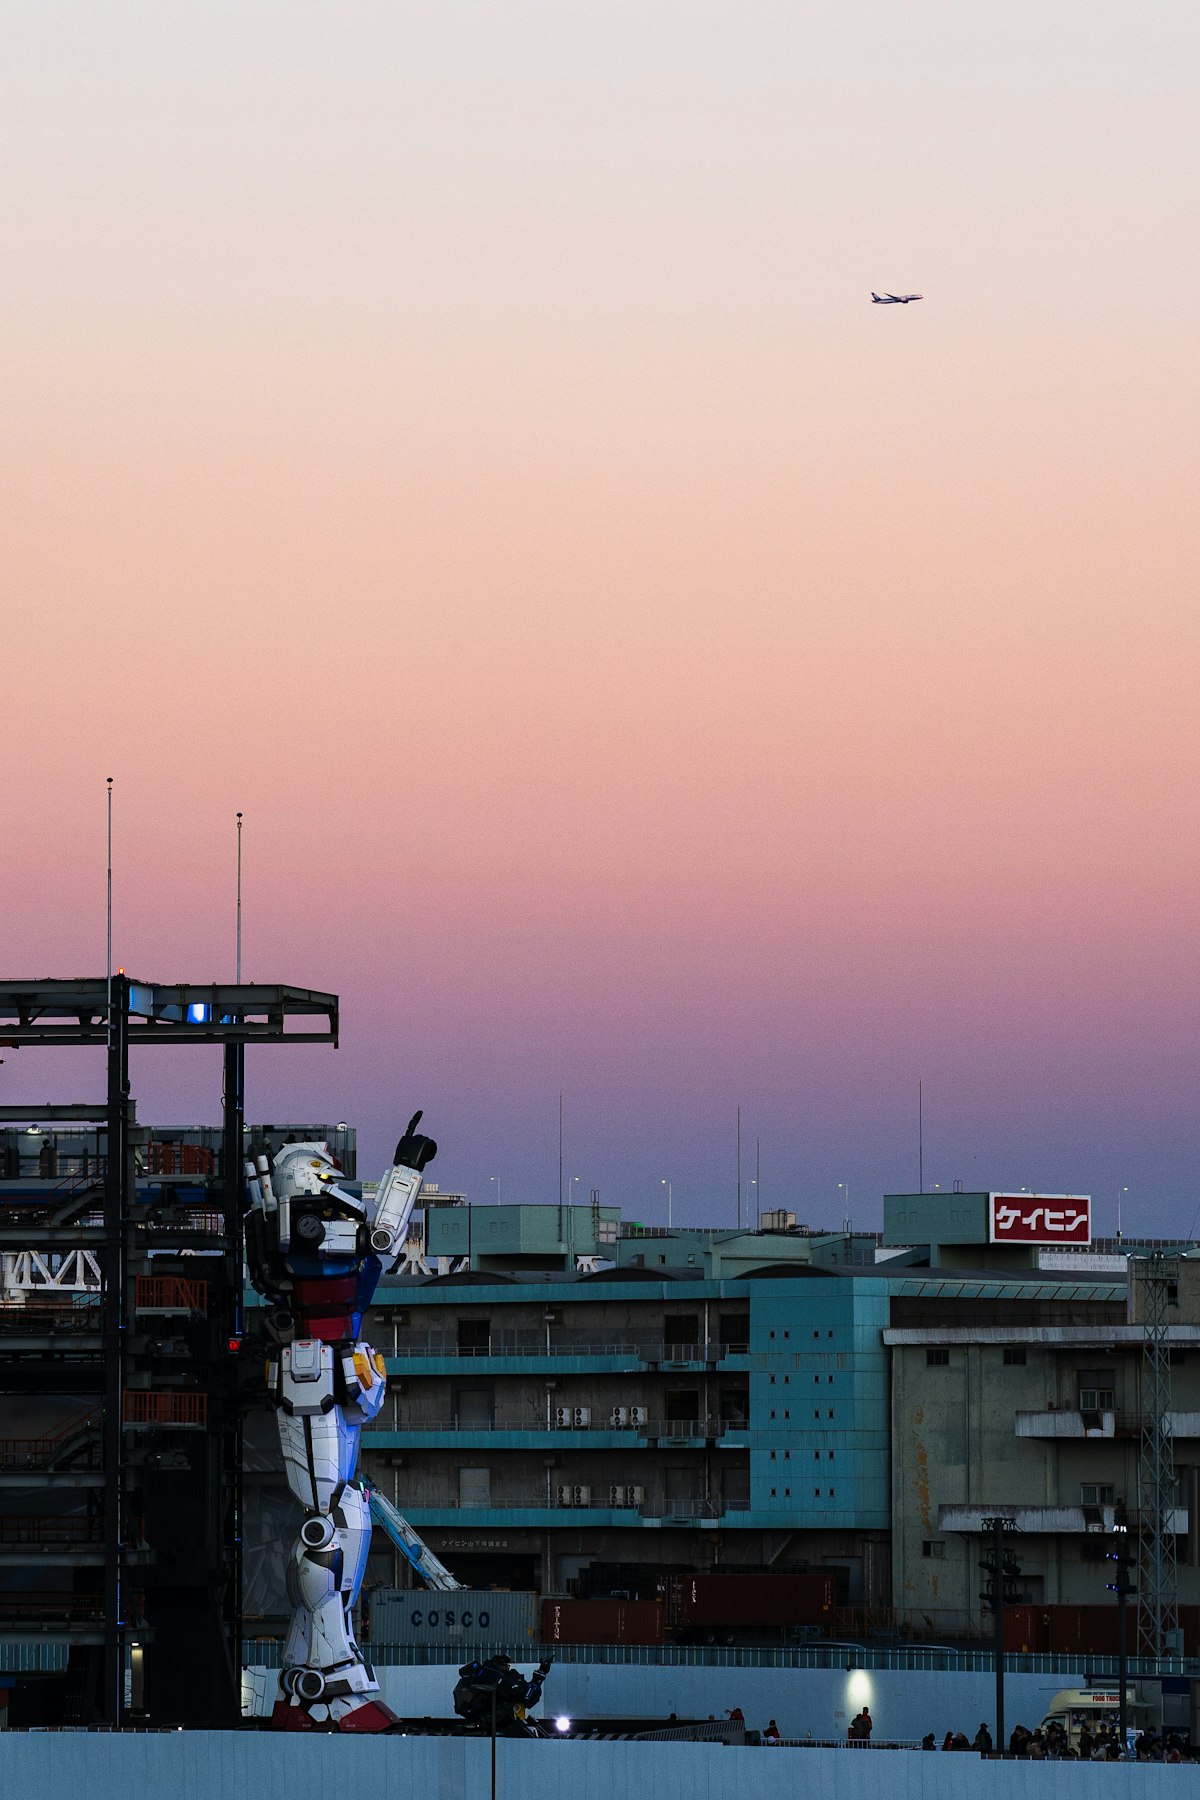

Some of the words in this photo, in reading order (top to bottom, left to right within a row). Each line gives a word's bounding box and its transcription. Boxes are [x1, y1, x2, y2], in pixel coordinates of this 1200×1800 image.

[996, 1205, 1087, 1231] ケイヒン
[411, 1610, 490, 1628] COSCO
